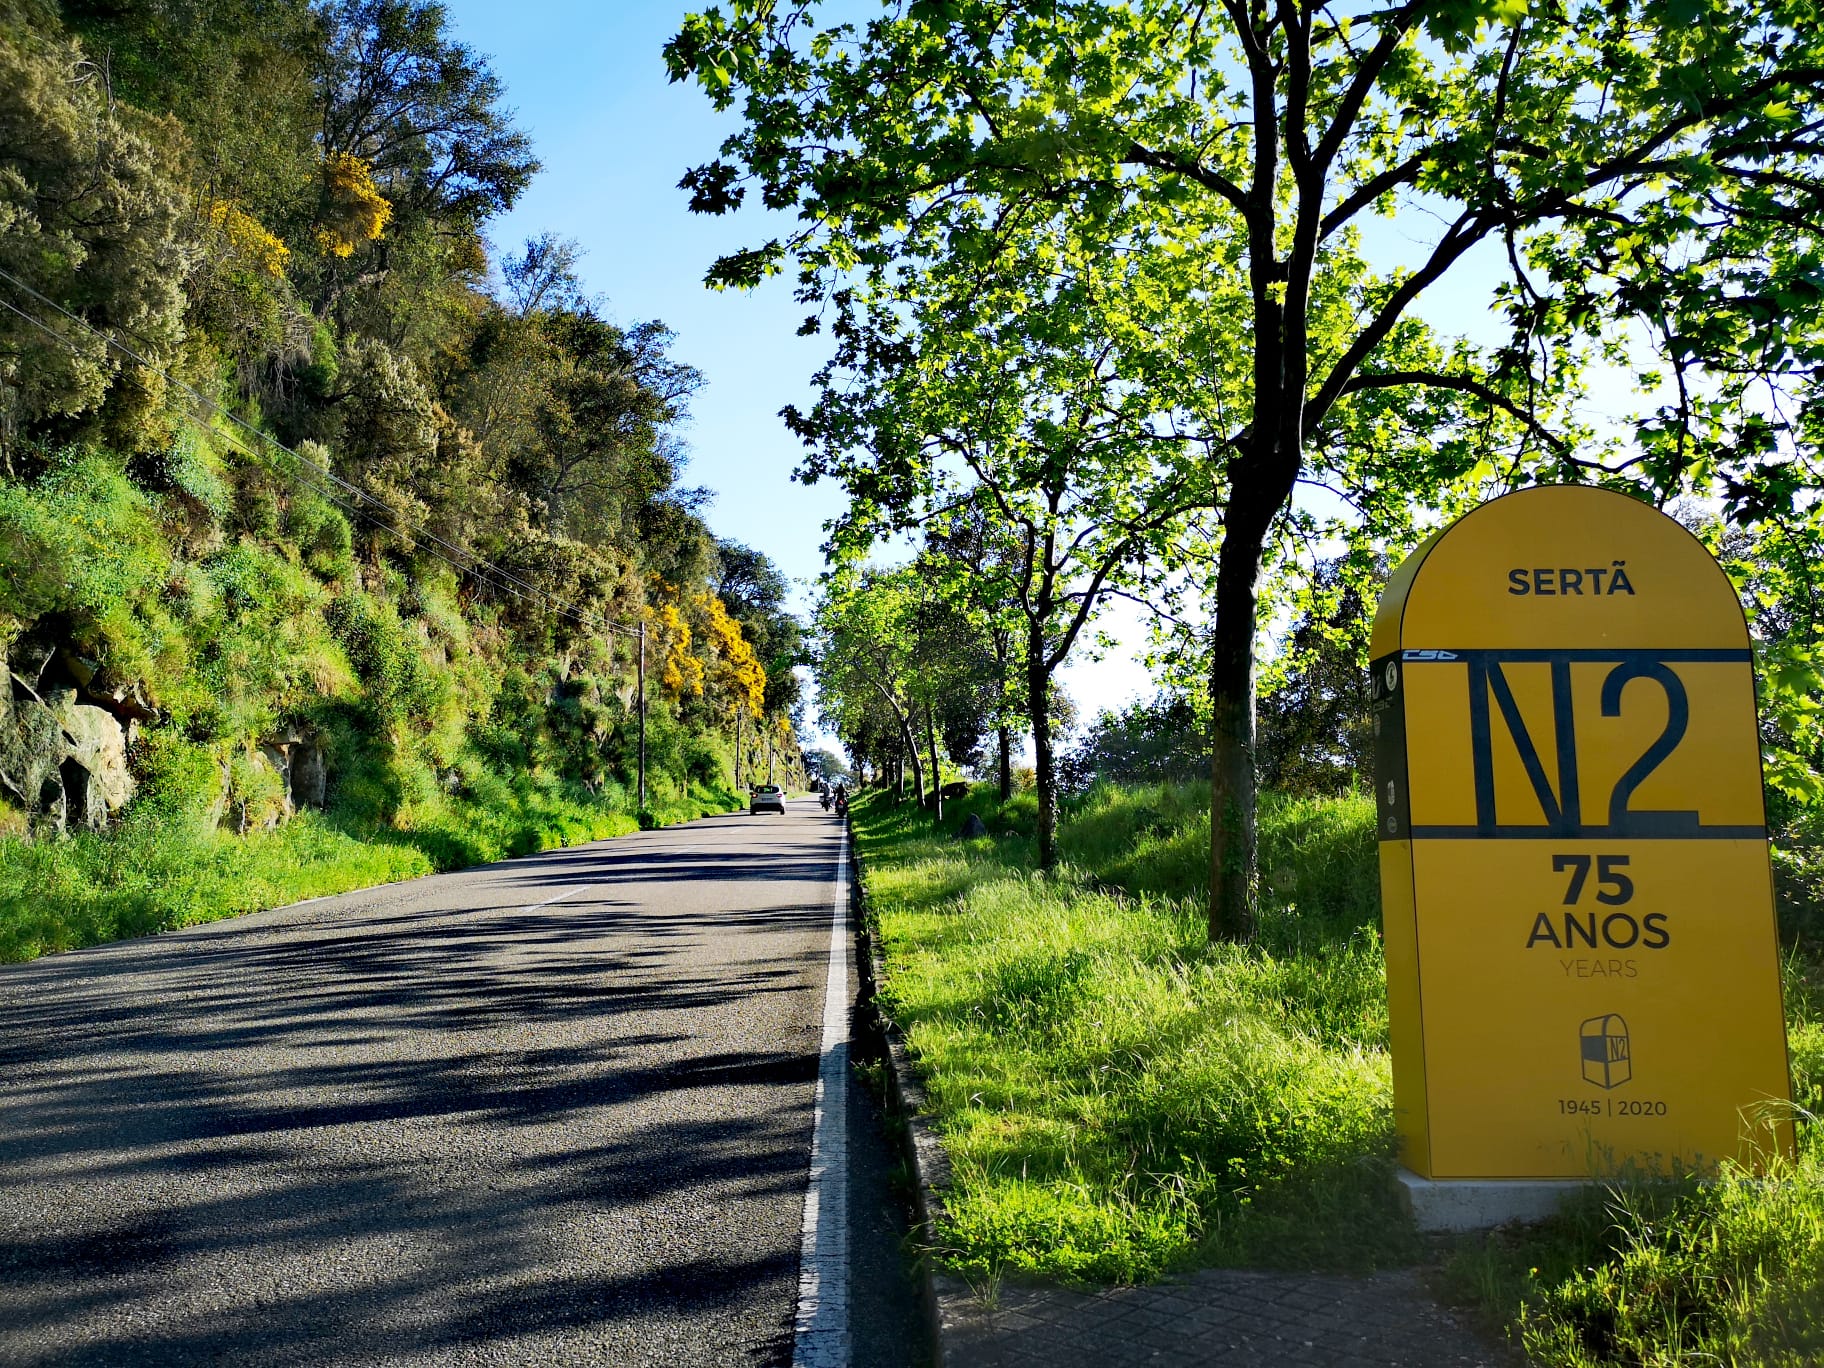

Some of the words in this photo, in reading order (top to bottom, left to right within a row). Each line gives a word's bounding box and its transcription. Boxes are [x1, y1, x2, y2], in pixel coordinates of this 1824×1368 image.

[1508, 560, 1635, 595] SERTÃ
[1467, 651, 1700, 837] N2
[1552, 854, 1634, 905] 75
[1526, 912, 1670, 949] ANOS
[1560, 959, 1638, 978] YEARS
[1610, 1037, 1627, 1060] N2
[1558, 1100, 1601, 1115] 1945
[1618, 1101, 1667, 1116] 2020
